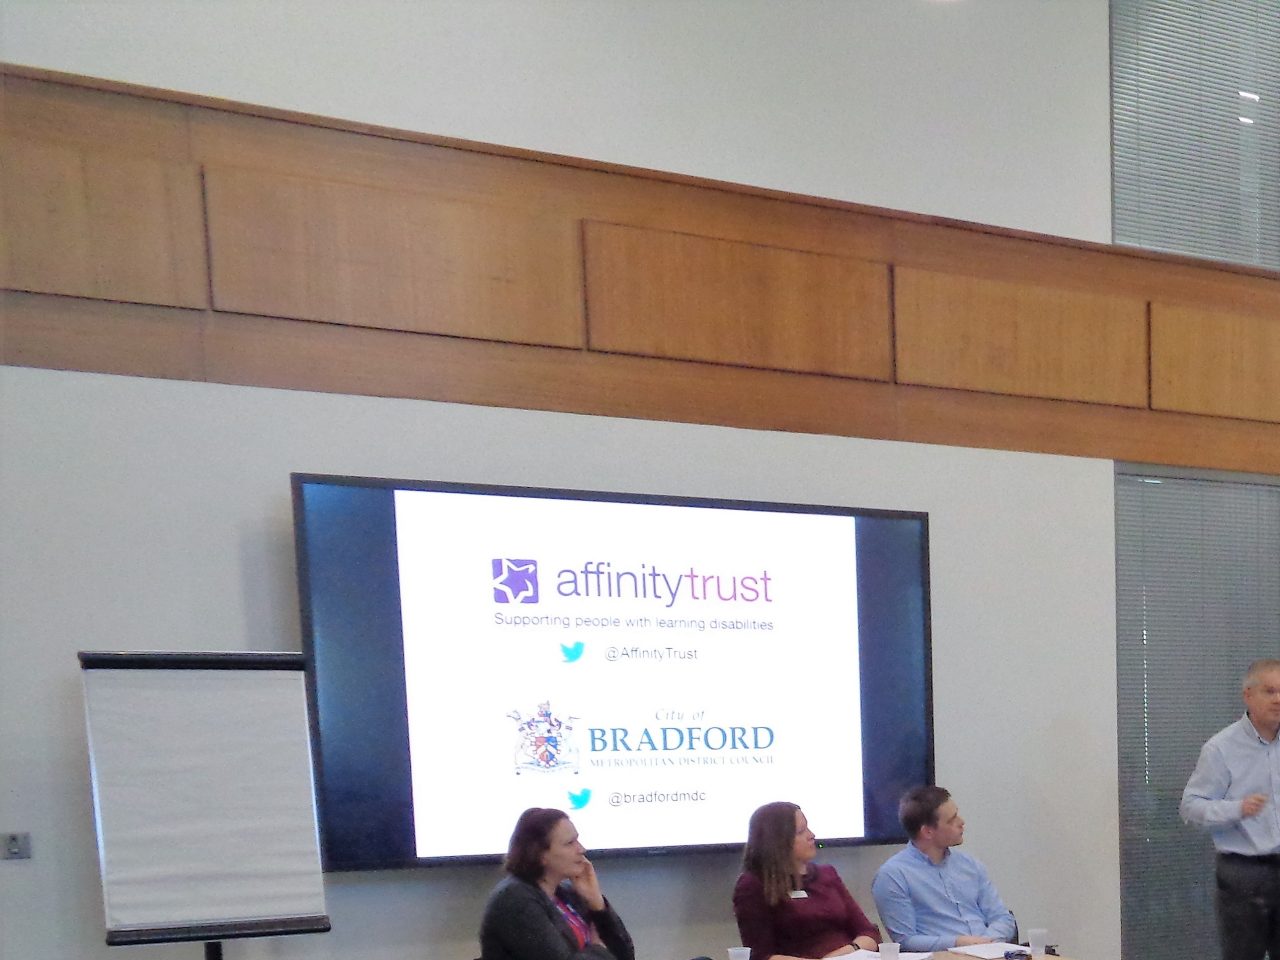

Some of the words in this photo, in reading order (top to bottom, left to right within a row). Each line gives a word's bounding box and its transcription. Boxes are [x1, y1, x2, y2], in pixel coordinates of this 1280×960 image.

[556, 561, 773, 608] affinitytrust
[494, 612, 571, 629] Supporting
[575, 615, 621, 629] people
[625, 616, 651, 628] with
[656, 617, 705, 632] learning
[709, 618, 774, 631] disabilities
[605, 646, 699, 662] @AffinityTrust
[655, 709, 684, 723] City
[588, 726, 774, 752] BRADFORD
[590, 756, 675, 768] METROPOLITAN
[679, 756, 726, 767] DISTRICT
[729, 755, 774, 765] COUNCIL
[608, 790, 707, 807] @bradfordmdc
